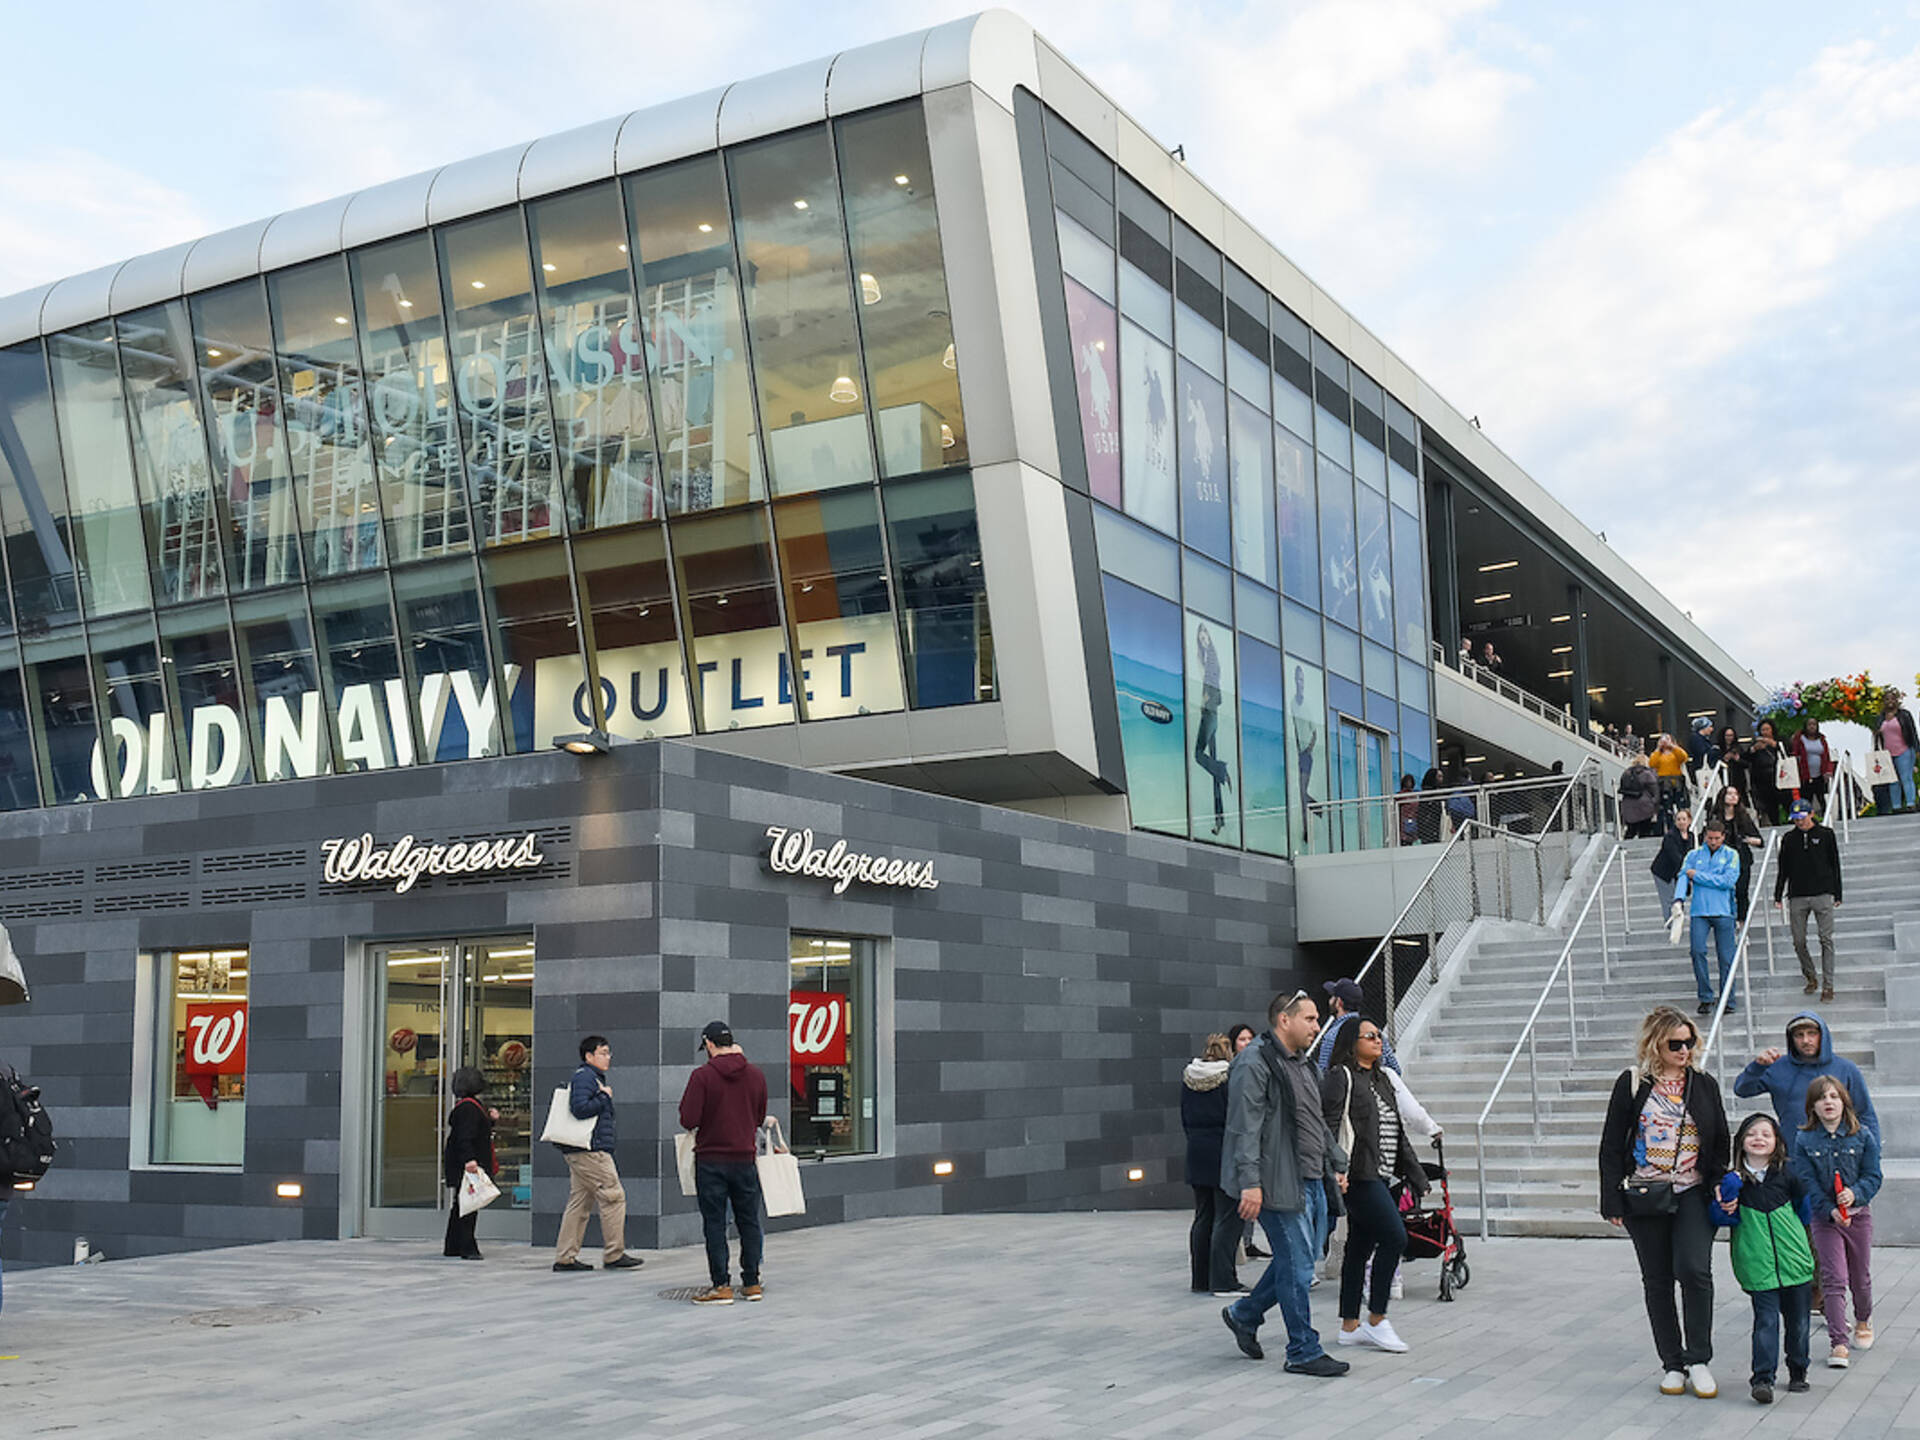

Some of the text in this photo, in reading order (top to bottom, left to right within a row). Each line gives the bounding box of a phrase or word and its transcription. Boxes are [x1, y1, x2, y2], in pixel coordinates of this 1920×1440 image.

[91, 642, 866, 800] OLD NAVY OUTLET
[320, 832, 544, 894] Walgreens
[765, 826, 940, 895] Walgreens
